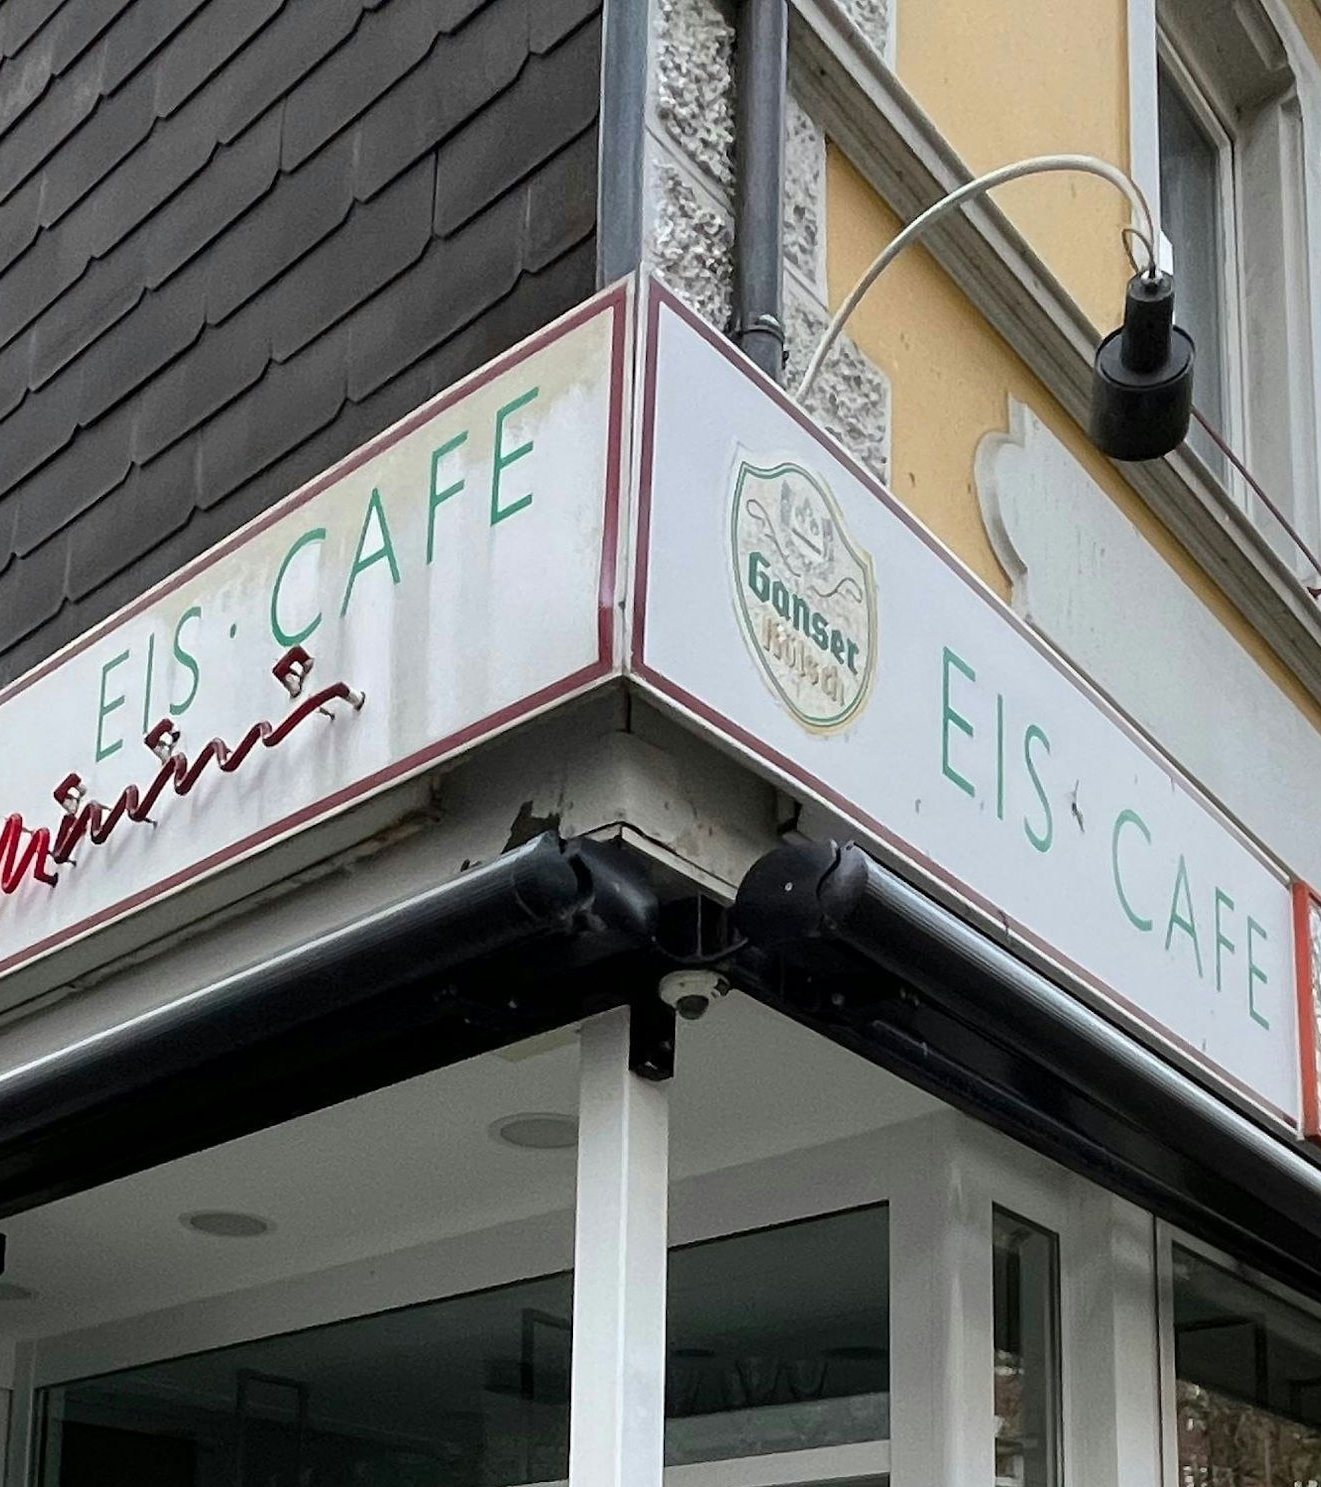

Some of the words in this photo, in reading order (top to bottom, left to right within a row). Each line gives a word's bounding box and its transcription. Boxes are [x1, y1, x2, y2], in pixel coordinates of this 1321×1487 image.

[95, 605, 201, 764] EIS
[271, 386, 540, 649] CAFE
[747, 551, 861, 677] Ganser
[940, 645, 1054, 854] EIS
[1112, 809, 1272, 1031] CAFE
